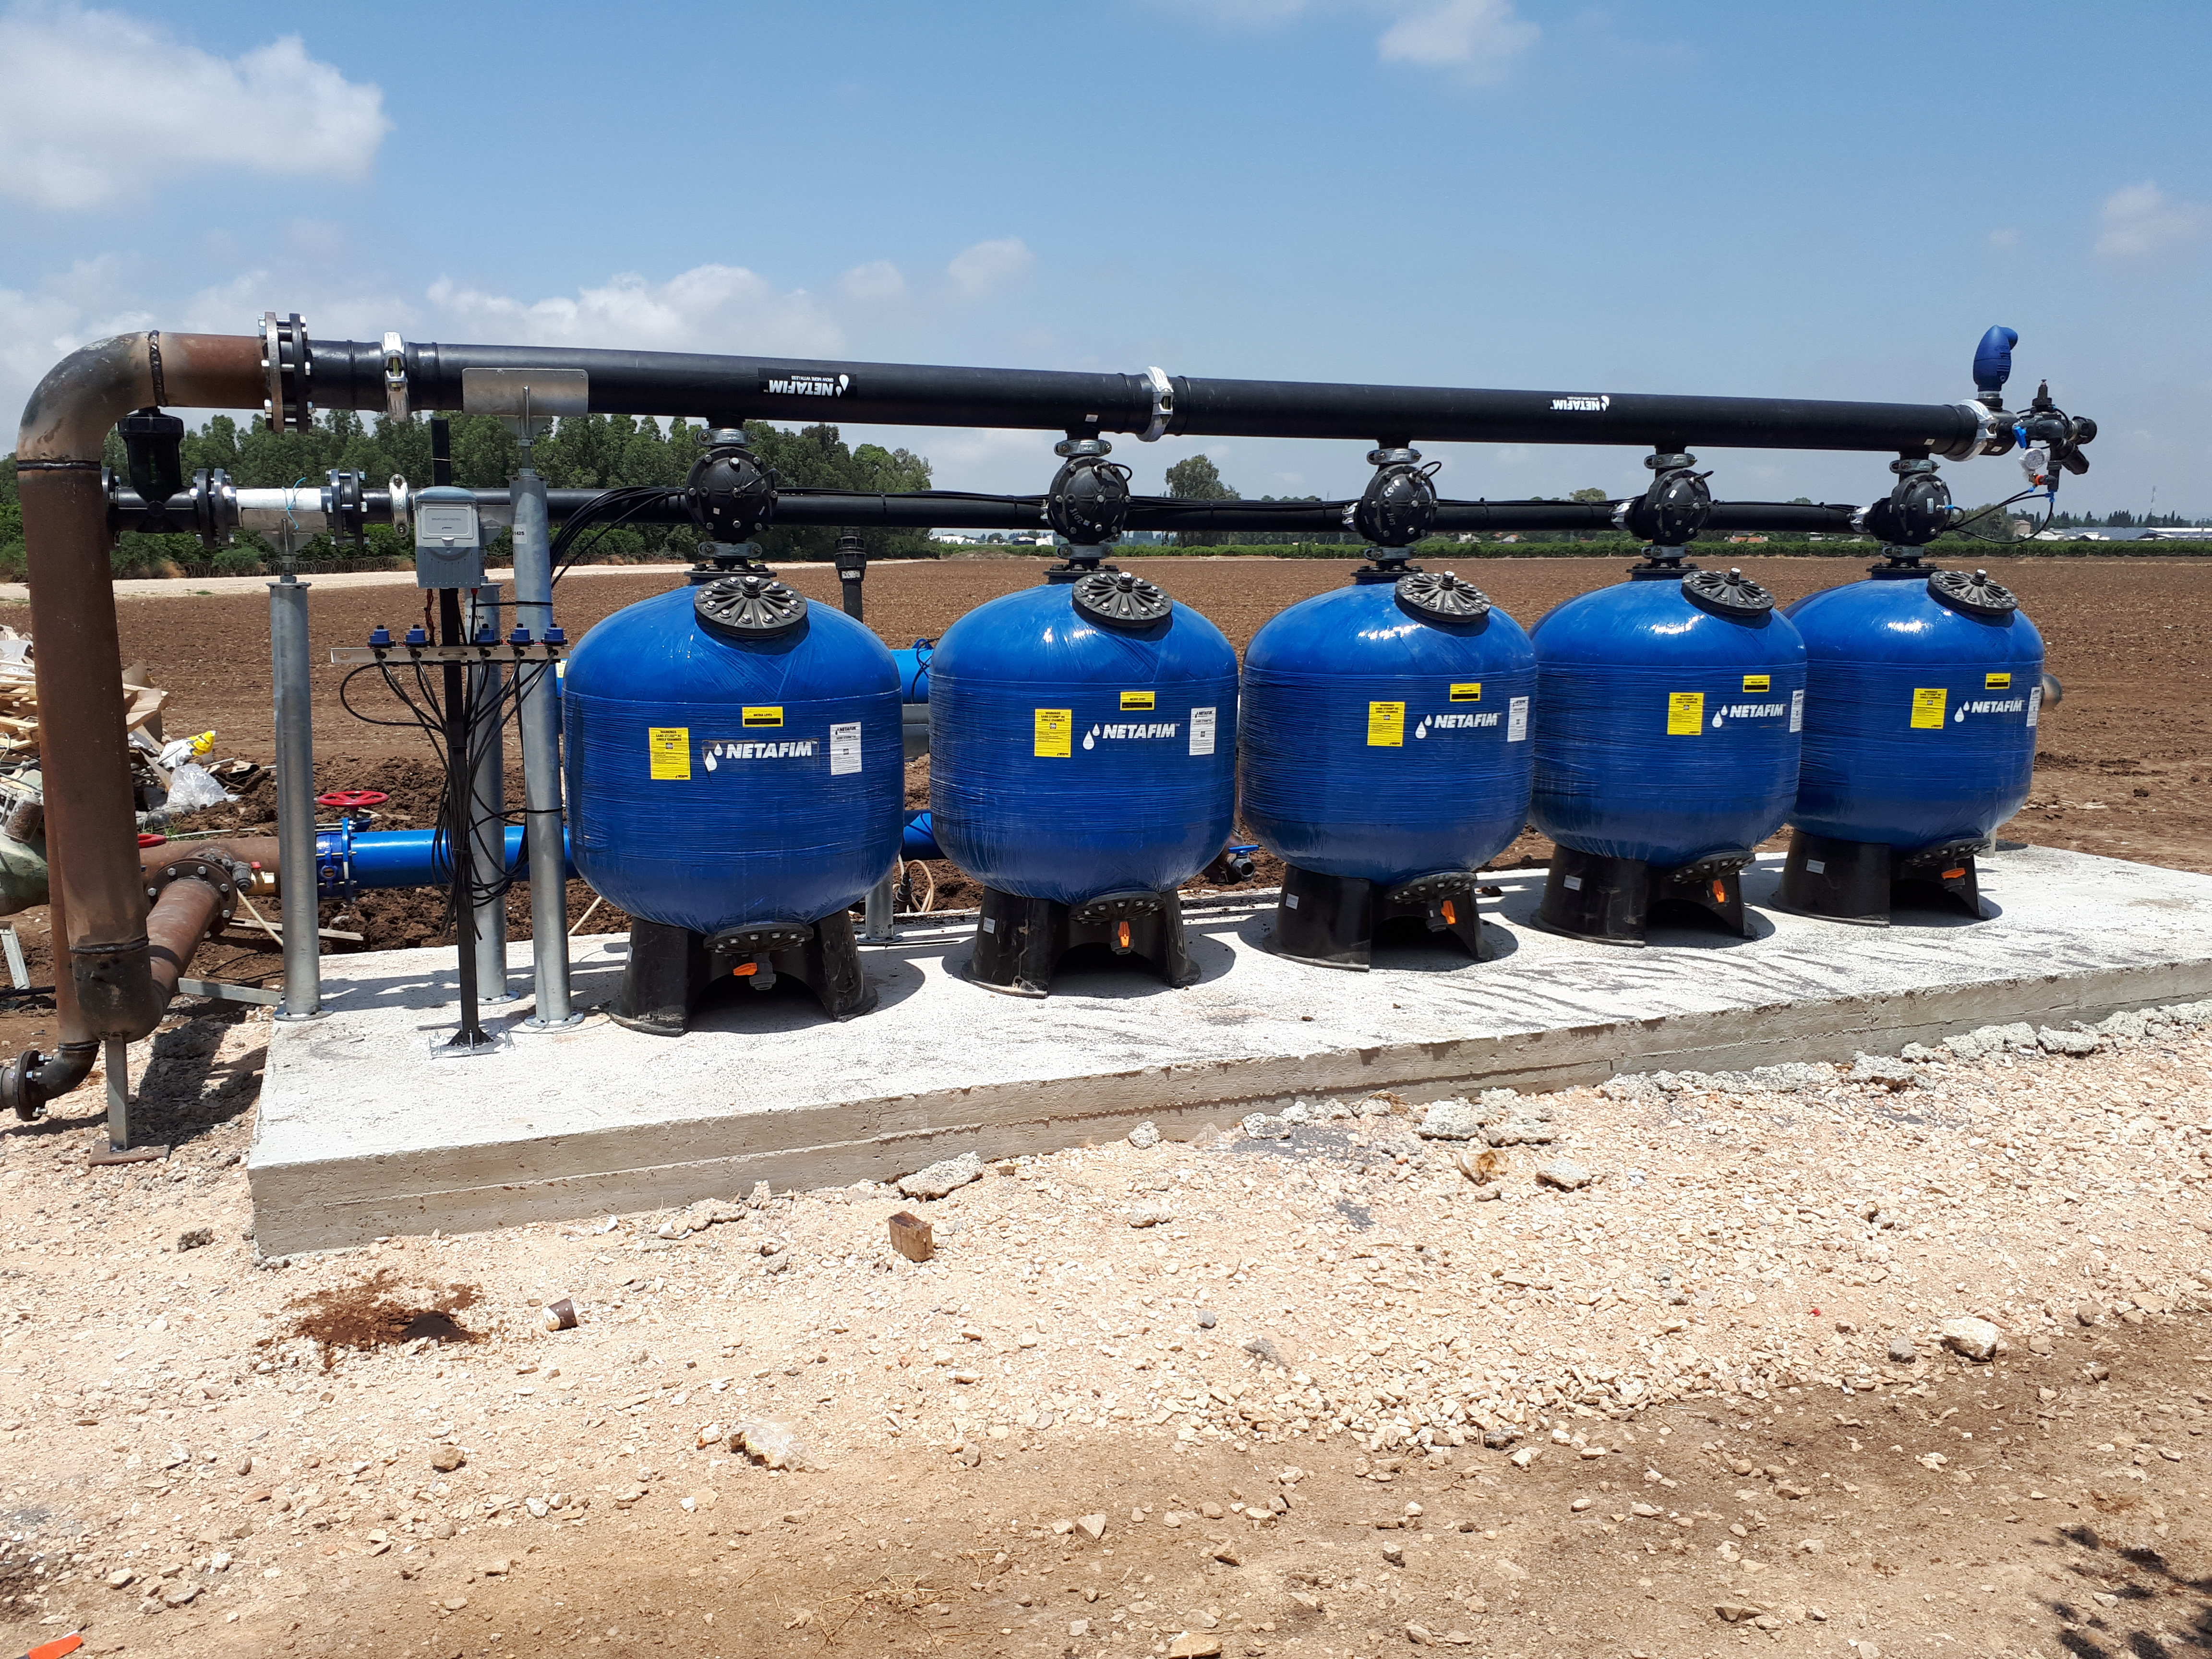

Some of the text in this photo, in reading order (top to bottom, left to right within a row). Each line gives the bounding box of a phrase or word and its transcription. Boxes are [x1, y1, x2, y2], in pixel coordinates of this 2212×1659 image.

[769, 380, 833, 396] NETAFIM
[1552, 399, 1600, 411] NETAFIM
[1070, 508, 1083, 524] 2018
[1729, 704, 1783, 718] NETAFIM
[1971, 700, 2022, 713] NETAFIM
[1434, 713, 1497, 728] NETAFIM
[1102, 723, 1176, 739] NETAFIM
[726, 742, 812, 759] NETAFIM
